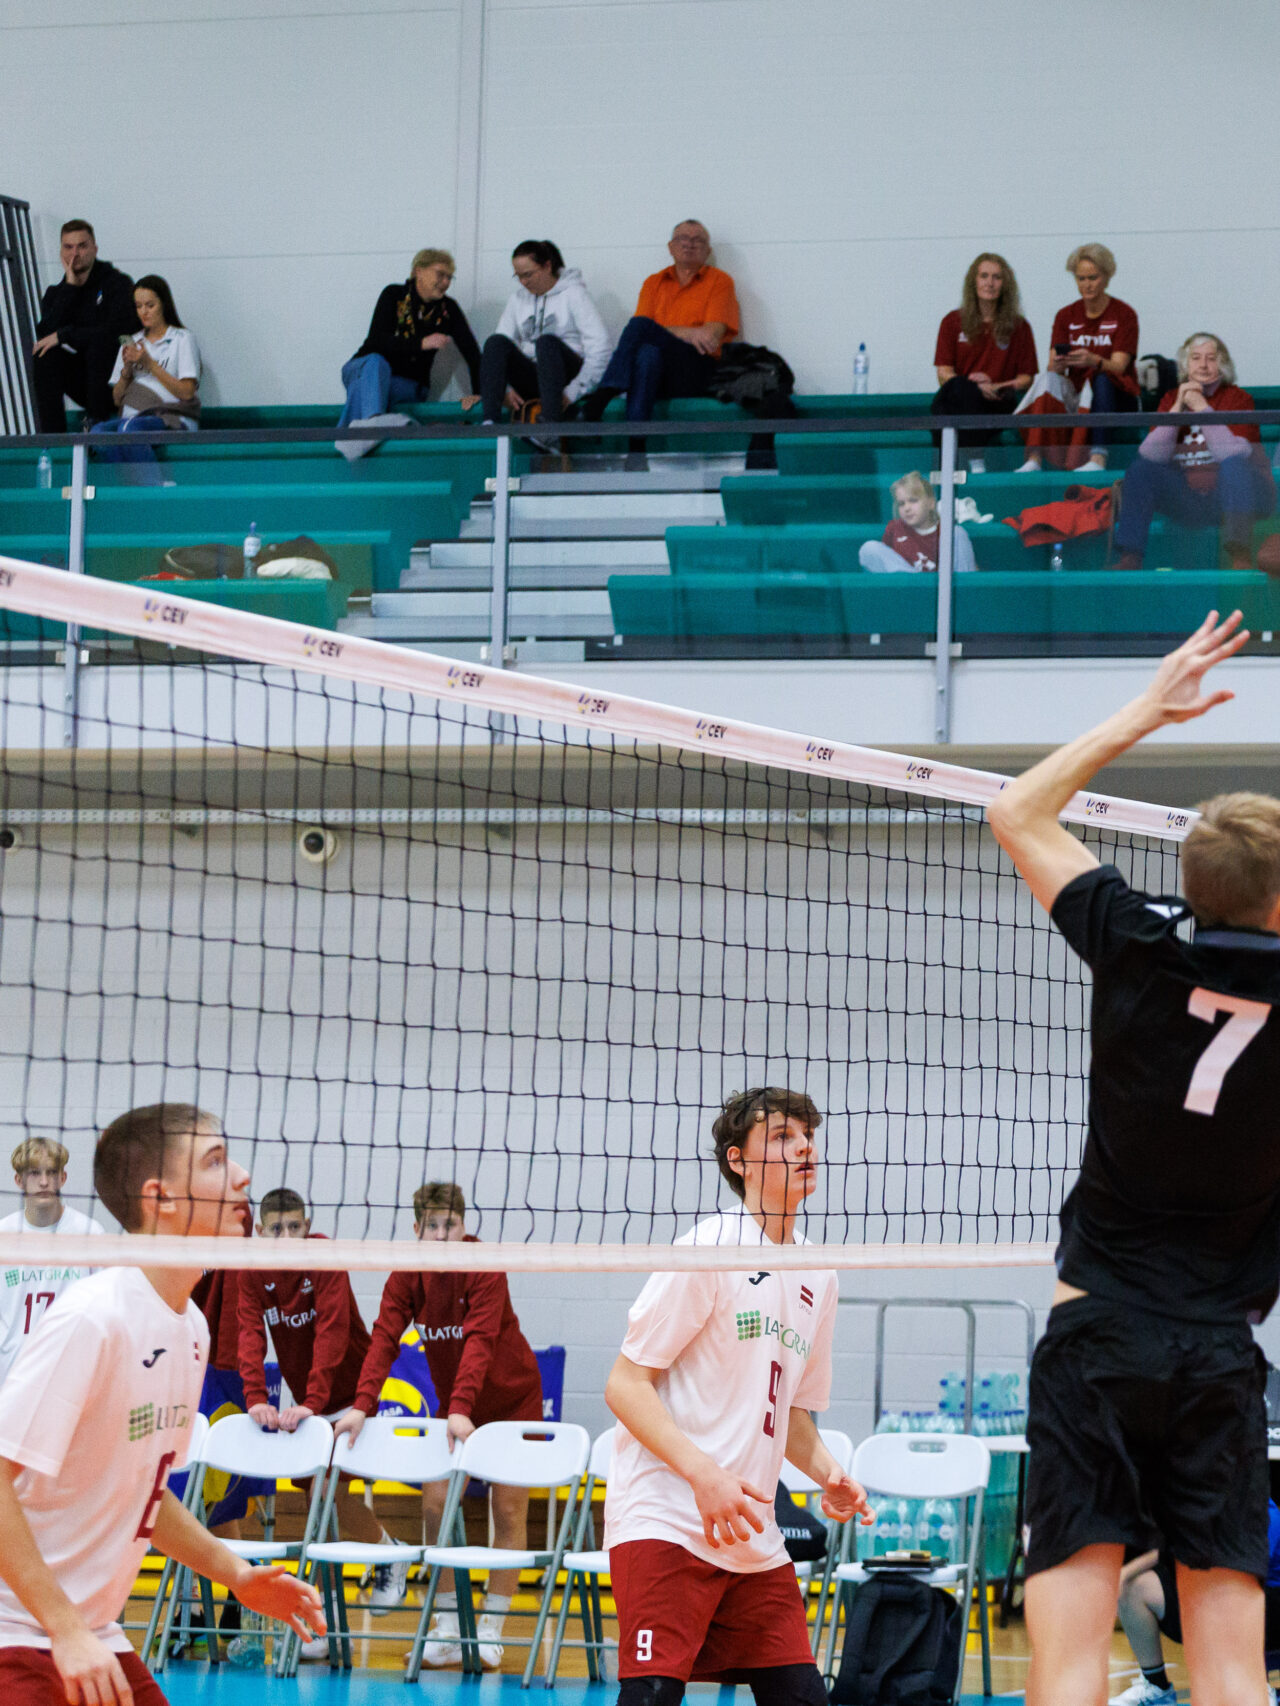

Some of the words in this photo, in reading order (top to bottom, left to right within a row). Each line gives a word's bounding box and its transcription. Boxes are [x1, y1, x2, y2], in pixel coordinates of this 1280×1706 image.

[161, 605, 189, 625] CEV
[319, 640, 344, 658] CEV
[461, 671, 486, 688] CEV
[591, 699, 610, 714] CEV
[708, 724, 727, 739] CEV
[817, 747, 834, 761] CEV
[916, 766, 933, 780] CEV
[1095, 802, 1110, 815] CEV
[1175, 815, 1189, 827] CEV
[1183, 986, 1272, 1116] 7
[22, 1268, 81, 1282] LATGRAN
[24, 1291, 56, 1335] 17
[636, 1629, 653, 1661] 9
